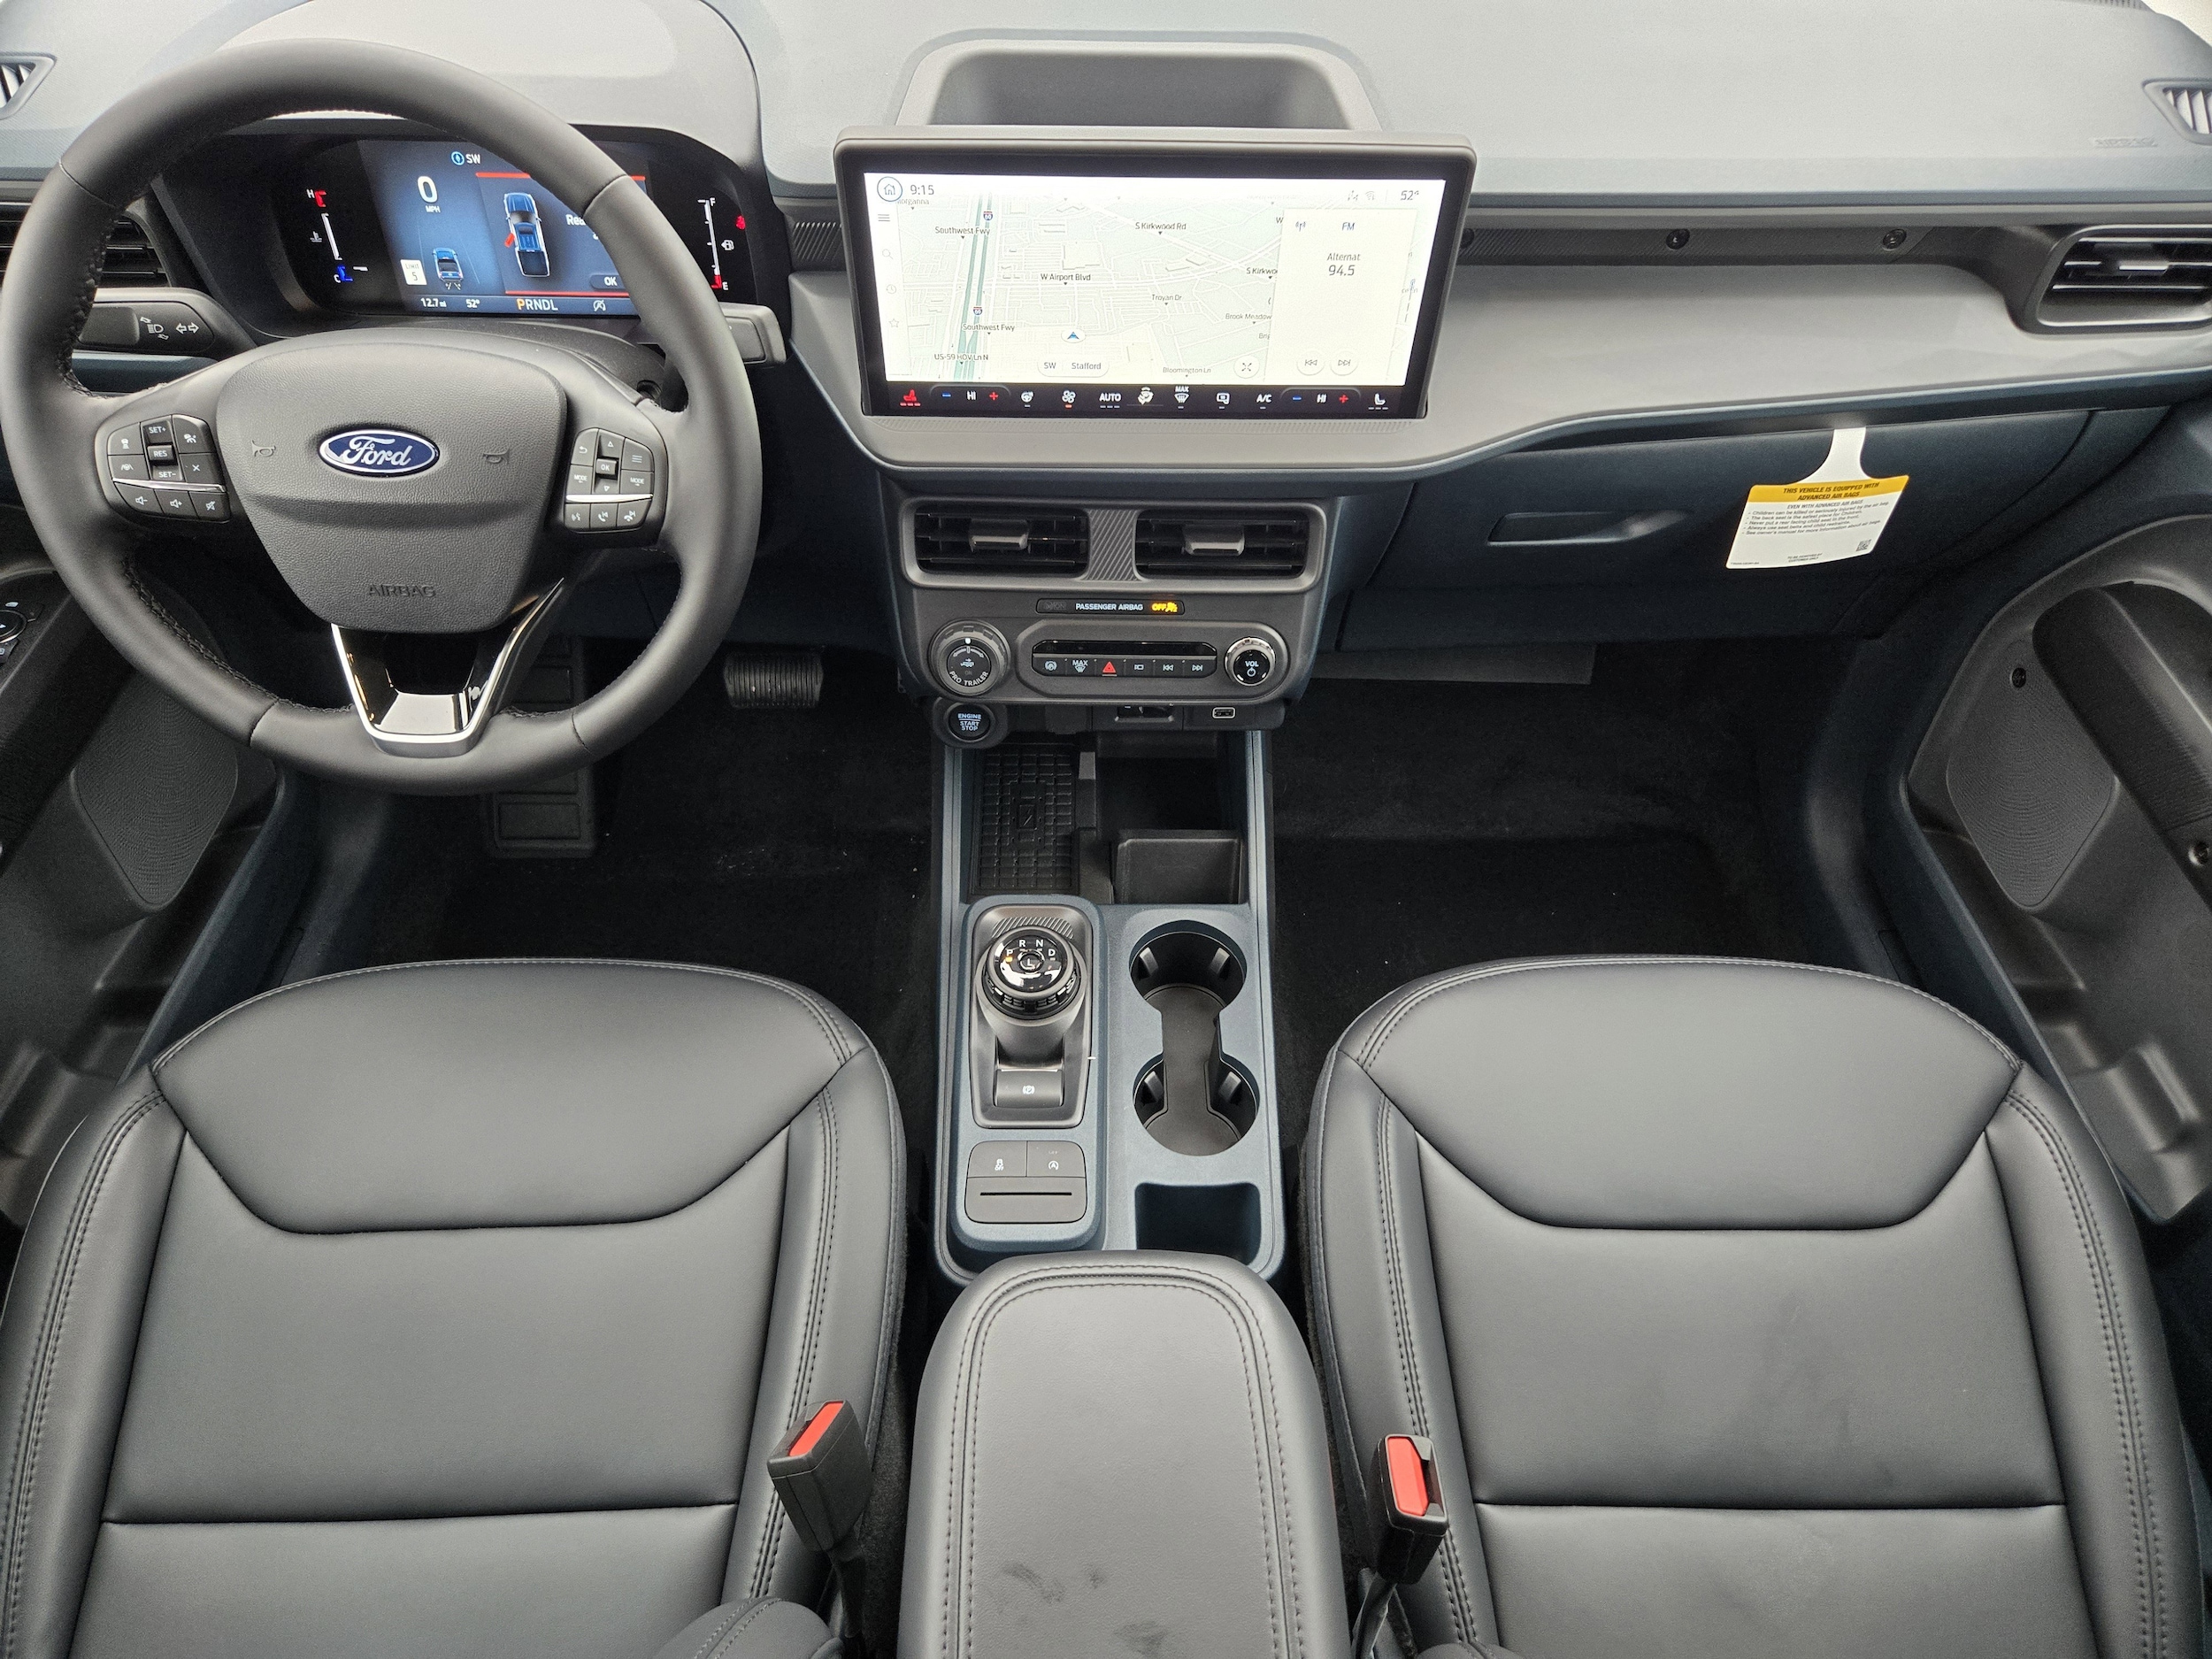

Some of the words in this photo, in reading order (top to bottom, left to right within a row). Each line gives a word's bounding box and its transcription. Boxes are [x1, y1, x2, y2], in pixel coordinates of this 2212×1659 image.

[465, 153, 480, 164] SW
[306, 188, 315, 198] H
[417, 175, 438, 204] 0
[910, 184, 934, 196] 9:15
[710, 197, 716, 207] F
[934, 226, 974, 234] Southwest
[975, 227, 990, 235] Fwy
[1326, 252, 1361, 261] Alternat
[1328, 265, 1356, 276] 94.5
[334, 274, 341, 283] C
[411, 272, 419, 281] 5
[603, 276, 618, 287] OK
[722, 281, 729, 290] E
[967, 390, 977, 400] HI
[1099, 392, 1122, 402] AUTO
[1256, 394, 1272, 403] A/C
[1317, 393, 1327, 403] HI
[338, 435, 413, 466] Ford
[369, 583, 436, 597] AIRBAG
[1151, 602, 1166, 611] OFF
[949, 671, 962, 684] PRO
[964, 671, 988, 687] TRAILER
